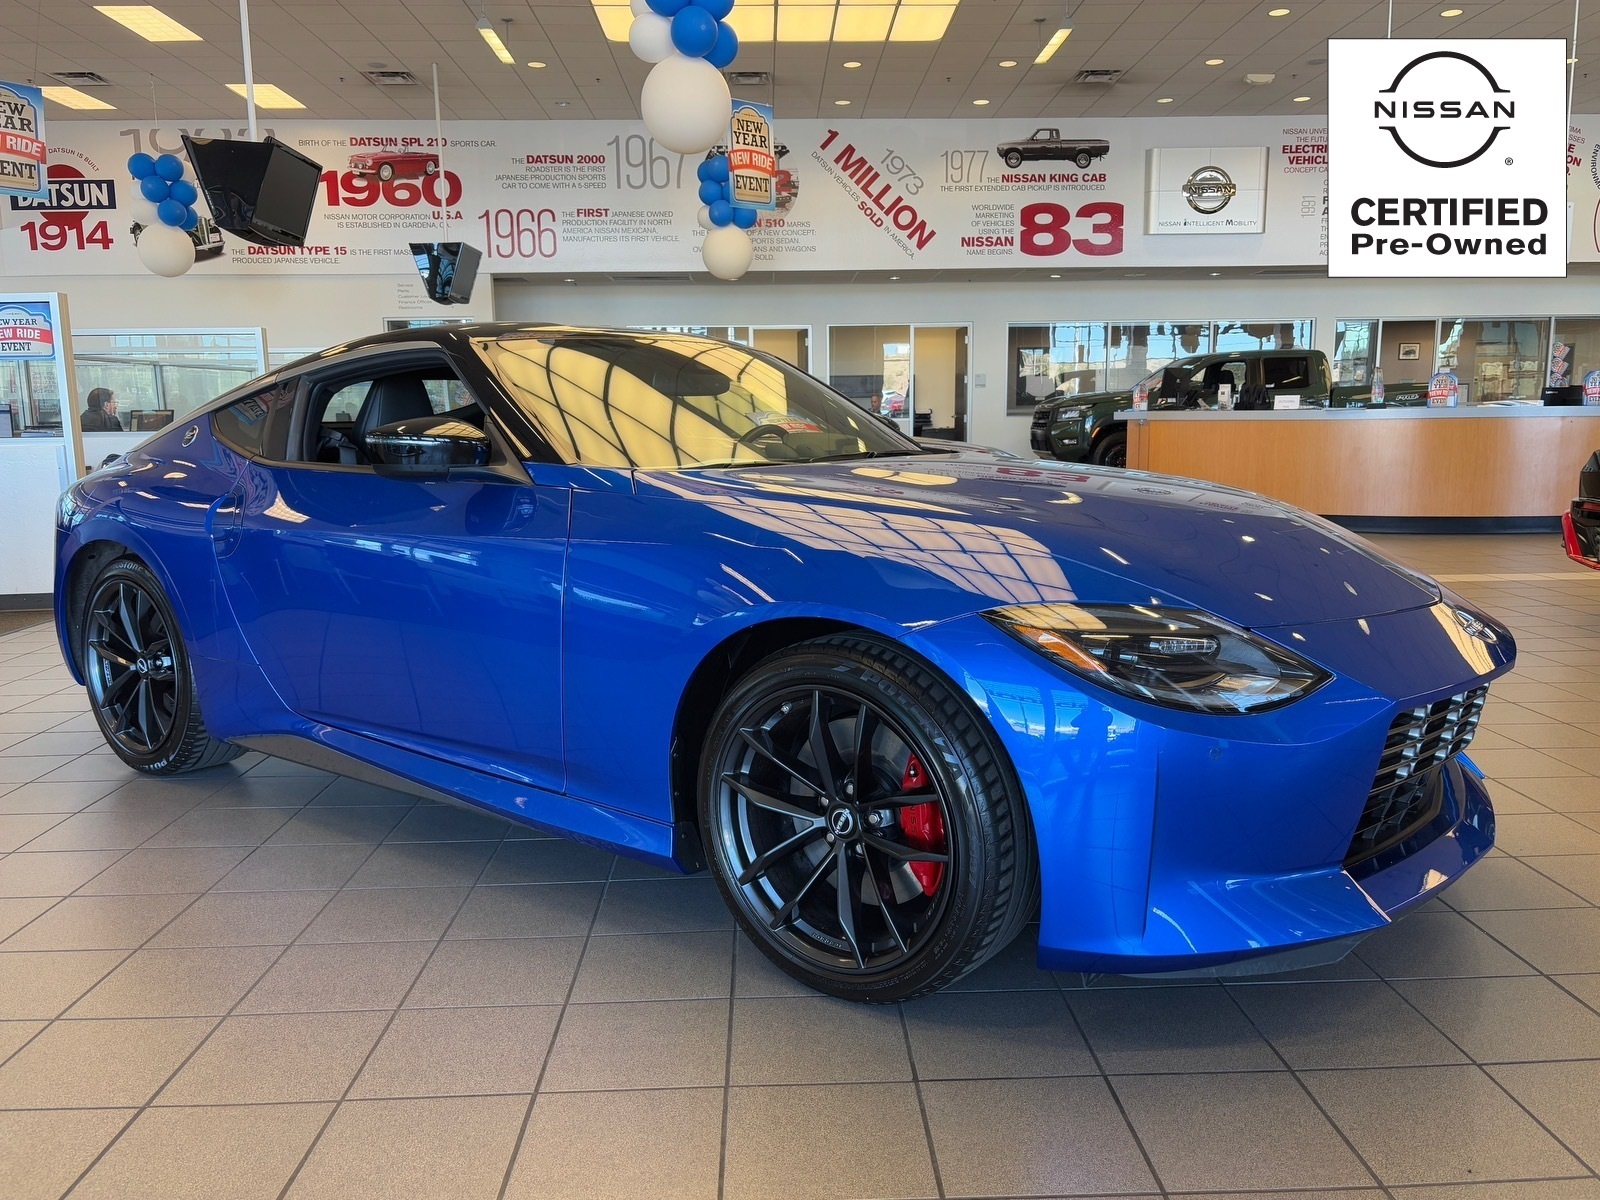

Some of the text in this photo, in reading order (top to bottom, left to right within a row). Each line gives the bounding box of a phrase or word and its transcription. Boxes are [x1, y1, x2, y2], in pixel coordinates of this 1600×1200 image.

[0, 100, 26, 116] EW
[0, 115, 34, 132] AR
[736, 118, 763, 134] NEW
[6, 135, 42, 157] RIDE
[298, 139, 320, 147] BIRTH
[321, 139, 330, 147] OF
[332, 139, 347, 147] THE
[349, 137, 398, 147] DATSUN
[401, 137, 424, 147] SPL
[426, 137, 448, 147] 210
[450, 139, 479, 147] SPORTS
[733, 131, 768, 149] YEAR
[1282, 144, 1328, 154] ELECTRI
[48, 147, 76, 155] DATSUN
[84, 156, 100, 172] BUILT
[526, 154, 574, 164] DATSUN
[576, 154, 606, 164] 2000
[730, 151, 773, 170] NEW RIDE
[940, 150, 990, 184] 1977
[1288, 155, 1328, 165] VEHICL
[1590, 143, 1600, 190] ENVIRONM
[0, 160, 36, 180] ENT
[880, 148, 925, 196] 1973
[1001, 174, 1046, 183] NISSAN
[1049, 173, 1079, 183] KING
[1081, 173, 1107, 183] CAB
[1283, 166, 1317, 174] CONCEPT
[320, 170, 463, 207] 1960
[735, 174, 770, 193] EVENT
[819, 128, 937, 251] 1 MILLION
[1188, 184, 1232, 194] NISSAN
[811, 151, 835, 176] DATSUN
[833, 173, 861, 202] VEHICLES
[857, 200, 884, 228] SOLD
[884, 225, 892, 234] IN
[576, 208, 610, 217] FIRST
[1301, 195, 1316, 219] 1991
[765, 218, 785, 228] 510
[1020, 202, 1125, 257] 83
[20, 221, 114, 251] 1914
[477, 208, 558, 259] 1966
[961, 236, 1014, 247] NISSAN
[247, 245, 296, 256] DATSUN
[300, 245, 331, 256] TYPE
[333, 245, 348, 256] 15
[12, 318, 38, 326] YEAR
[0, 328, 41, 340] EW RIDE
[1, 342, 32, 352] EVENT
